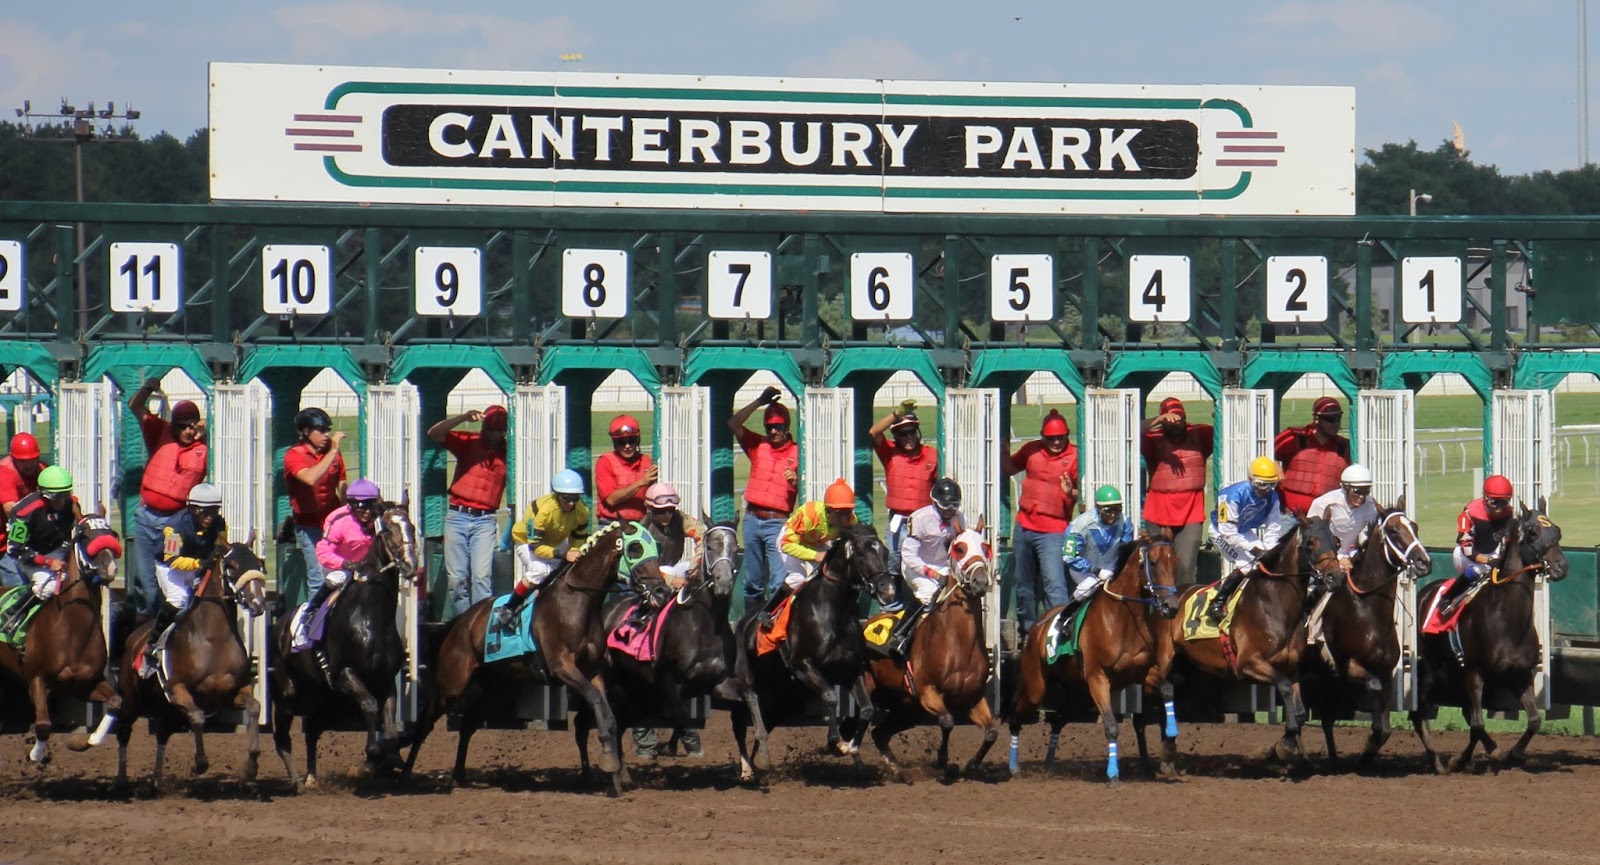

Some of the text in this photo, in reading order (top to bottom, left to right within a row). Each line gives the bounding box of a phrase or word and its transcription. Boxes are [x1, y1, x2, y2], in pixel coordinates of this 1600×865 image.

[428, 112, 1142, 172] CANTERBURY PARK
[120, 254, 161, 300] 11
[270, 258, 316, 304] 10
[435, 262, 459, 306] 9
[583, 263, 607, 307] 8
[728, 263, 751, 307] 7
[867, 267, 891, 310] 6
[1008, 267, 1031, 311] 5
[1142, 270, 1166, 312] 4
[1285, 269, 1308, 311] 2
[1419, 269, 1435, 312] 1
[10, 524, 25, 540] 12
[615, 537, 624, 551] 9
[1065, 539, 1075, 553] 5
